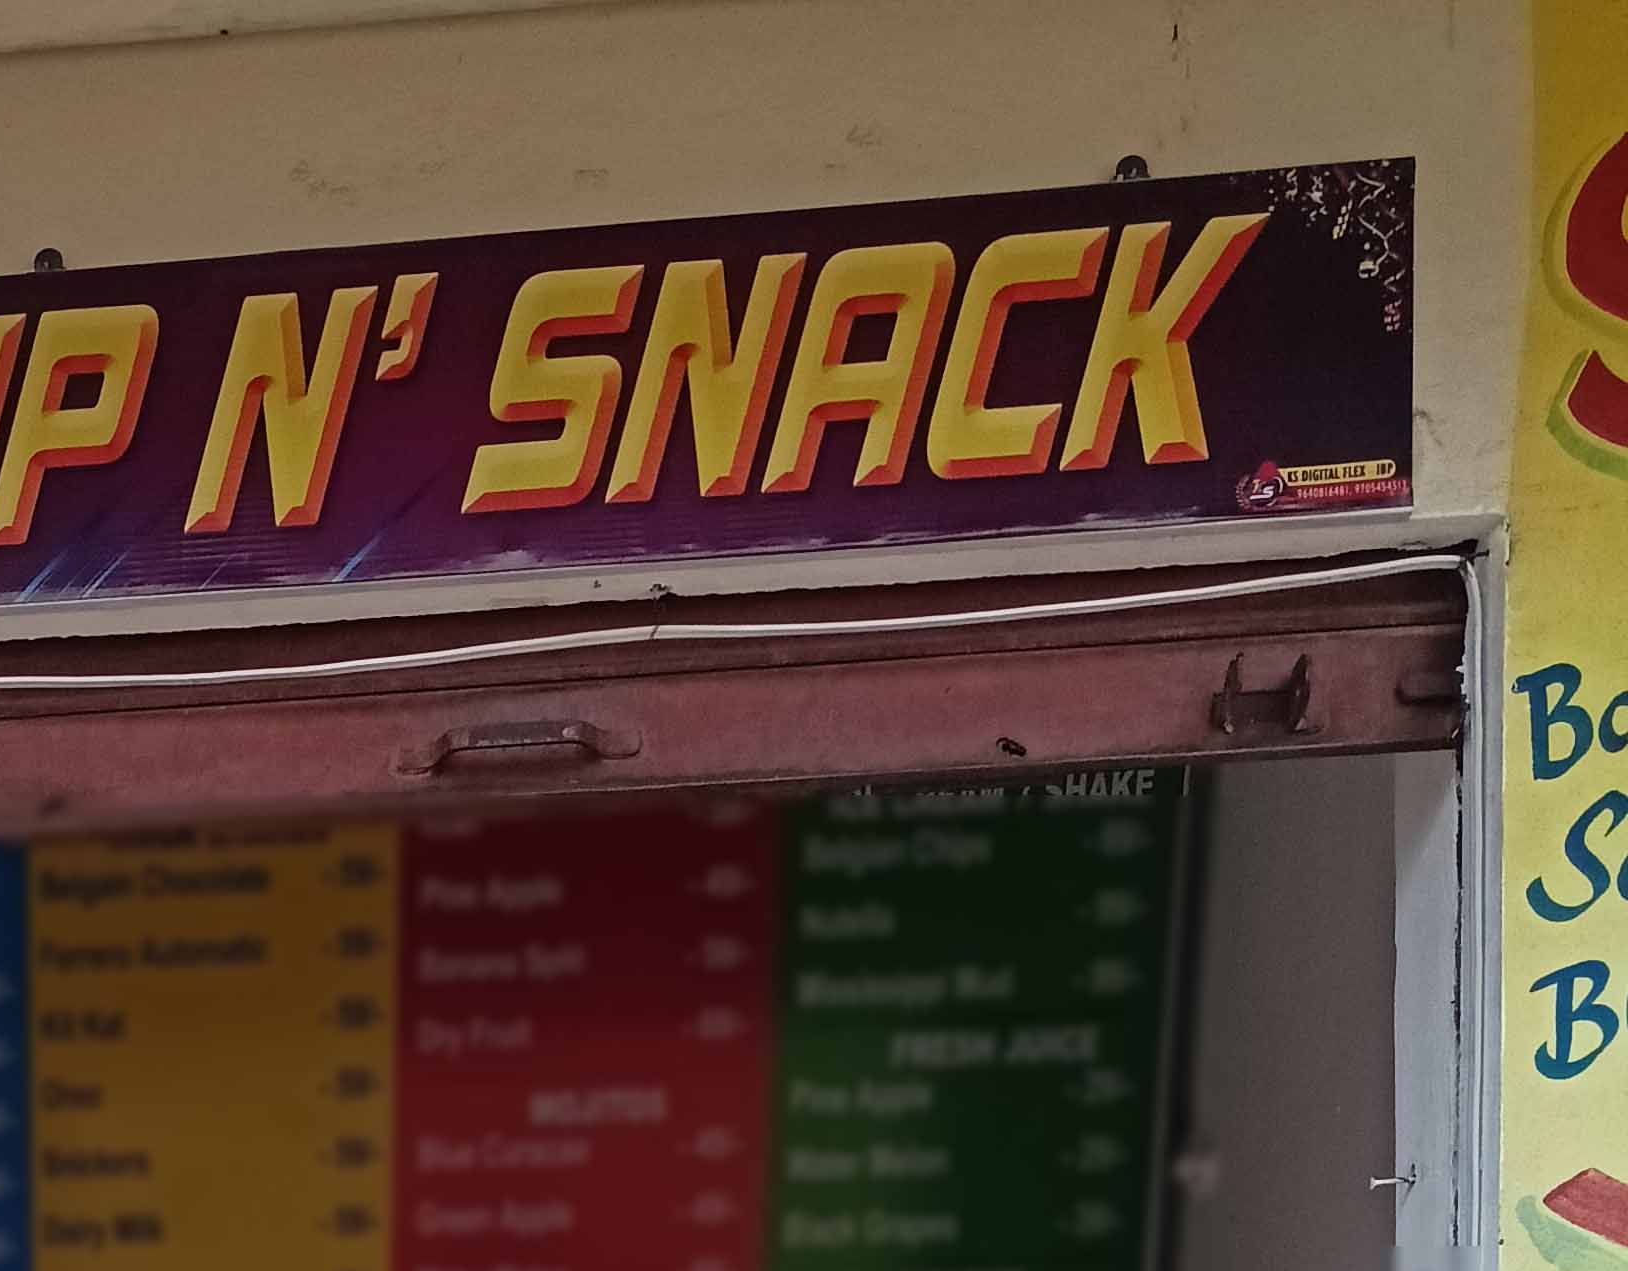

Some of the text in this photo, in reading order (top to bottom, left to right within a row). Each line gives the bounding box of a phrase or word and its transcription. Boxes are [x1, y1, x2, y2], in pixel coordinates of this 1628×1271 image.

[183, 272, 439, 534] N'
[462, 213, 1270, 514] SNACK
[1301, 467, 1340, 483] DIGITAL
[1343, 465, 1366, 479] FLEX
